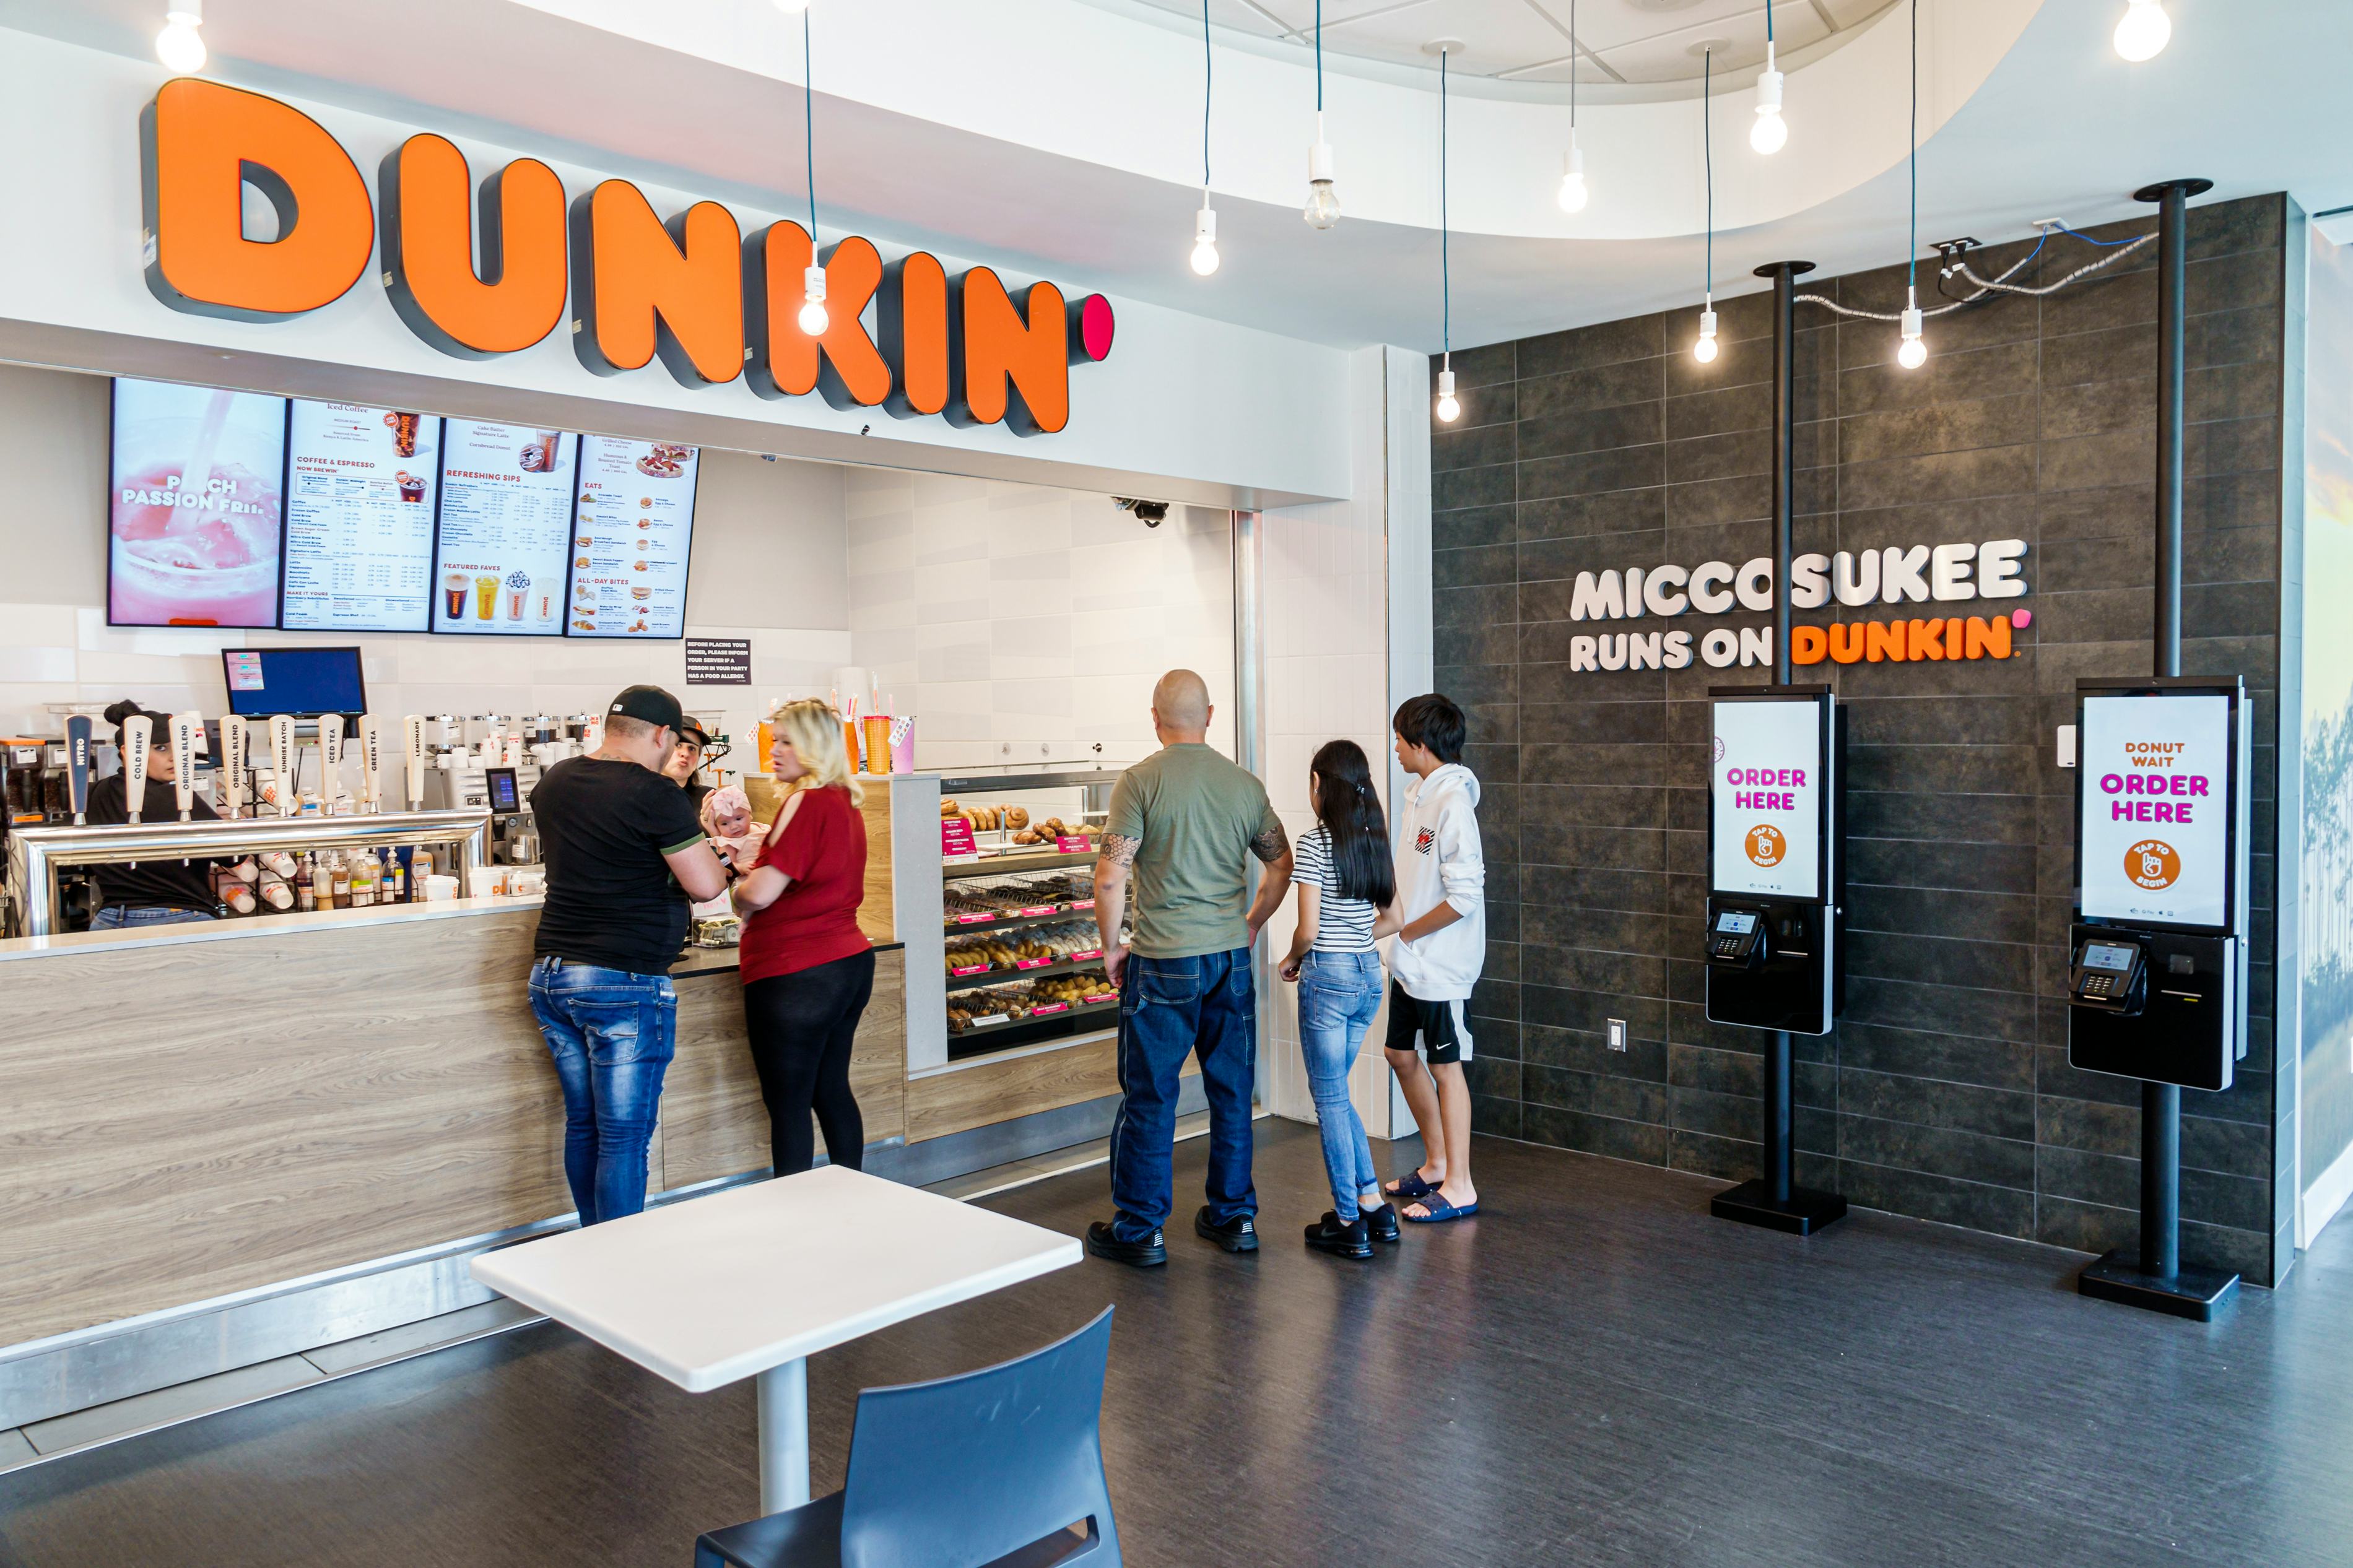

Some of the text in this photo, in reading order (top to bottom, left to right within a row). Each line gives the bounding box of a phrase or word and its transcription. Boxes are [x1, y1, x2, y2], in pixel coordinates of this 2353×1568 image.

[140, 78, 1115, 436] DUNKIN'
[297, 456, 328, 464] COFFEE
[337, 460, 375, 468] ESPRESSO
[446, 469, 521, 482] REFRESHING SIPS
[122, 489, 214, 509] PASSION
[1570, 539, 2028, 621] MICCOSUKEE
[1570, 630, 1693, 672] RUNS
[1700, 625, 1773, 667] ON
[77, 738, 85, 766] NITRO
[2125, 742, 2185, 753] DONUT
[2131, 756, 2174, 767] WAIT
[1727, 768, 1806, 787] ORDER
[2100, 773, 2209, 797] ORDER
[1735, 791, 1794, 810] HERE
[2112, 800, 2193, 823] HERE
[1752, 827, 1778, 838] TAP TO
[2134, 843, 2170, 855] TAP TO
[1754, 855, 1777, 865] BEGIN
[2136, 876, 2168, 887] BEGIN
